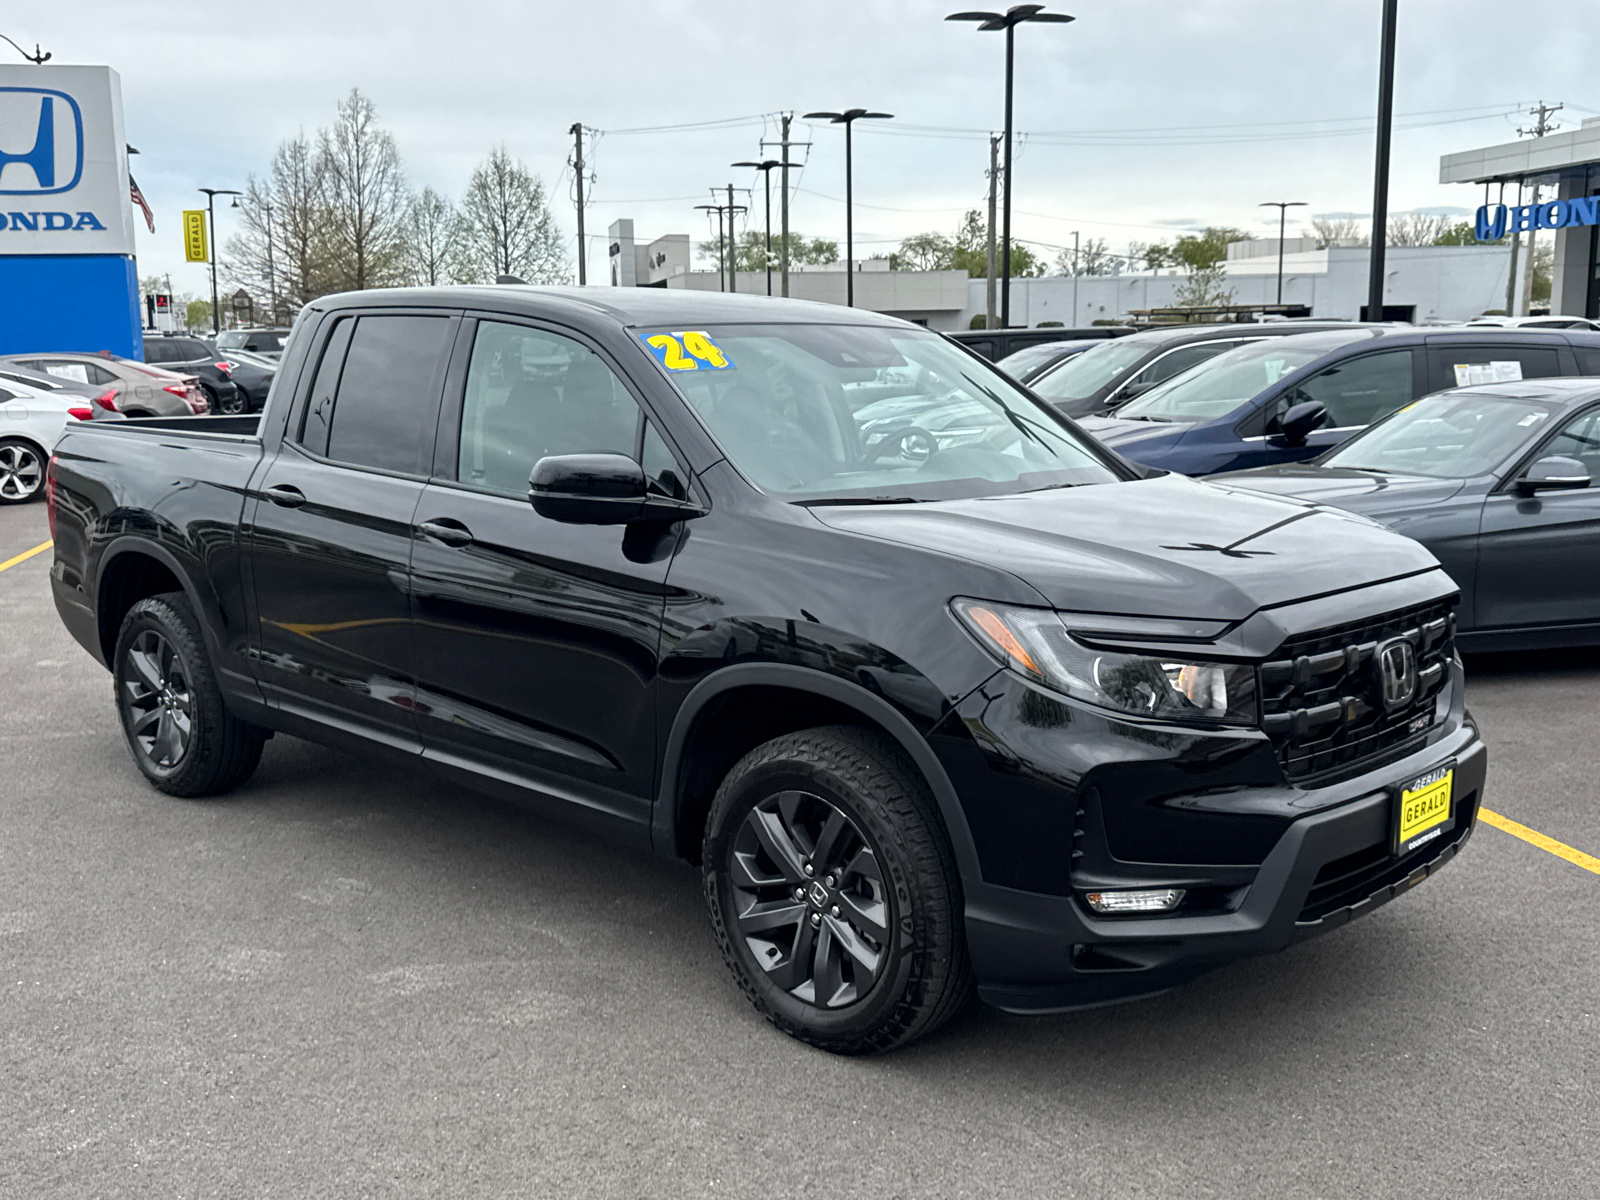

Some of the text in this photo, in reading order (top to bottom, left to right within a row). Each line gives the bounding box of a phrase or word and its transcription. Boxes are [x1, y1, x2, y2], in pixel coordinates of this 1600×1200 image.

[0, 211, 107, 231] NDA
[191, 216, 201, 257] GERALD
[646, 331, 729, 370] 24
[1406, 791, 1446, 823] GERALD
